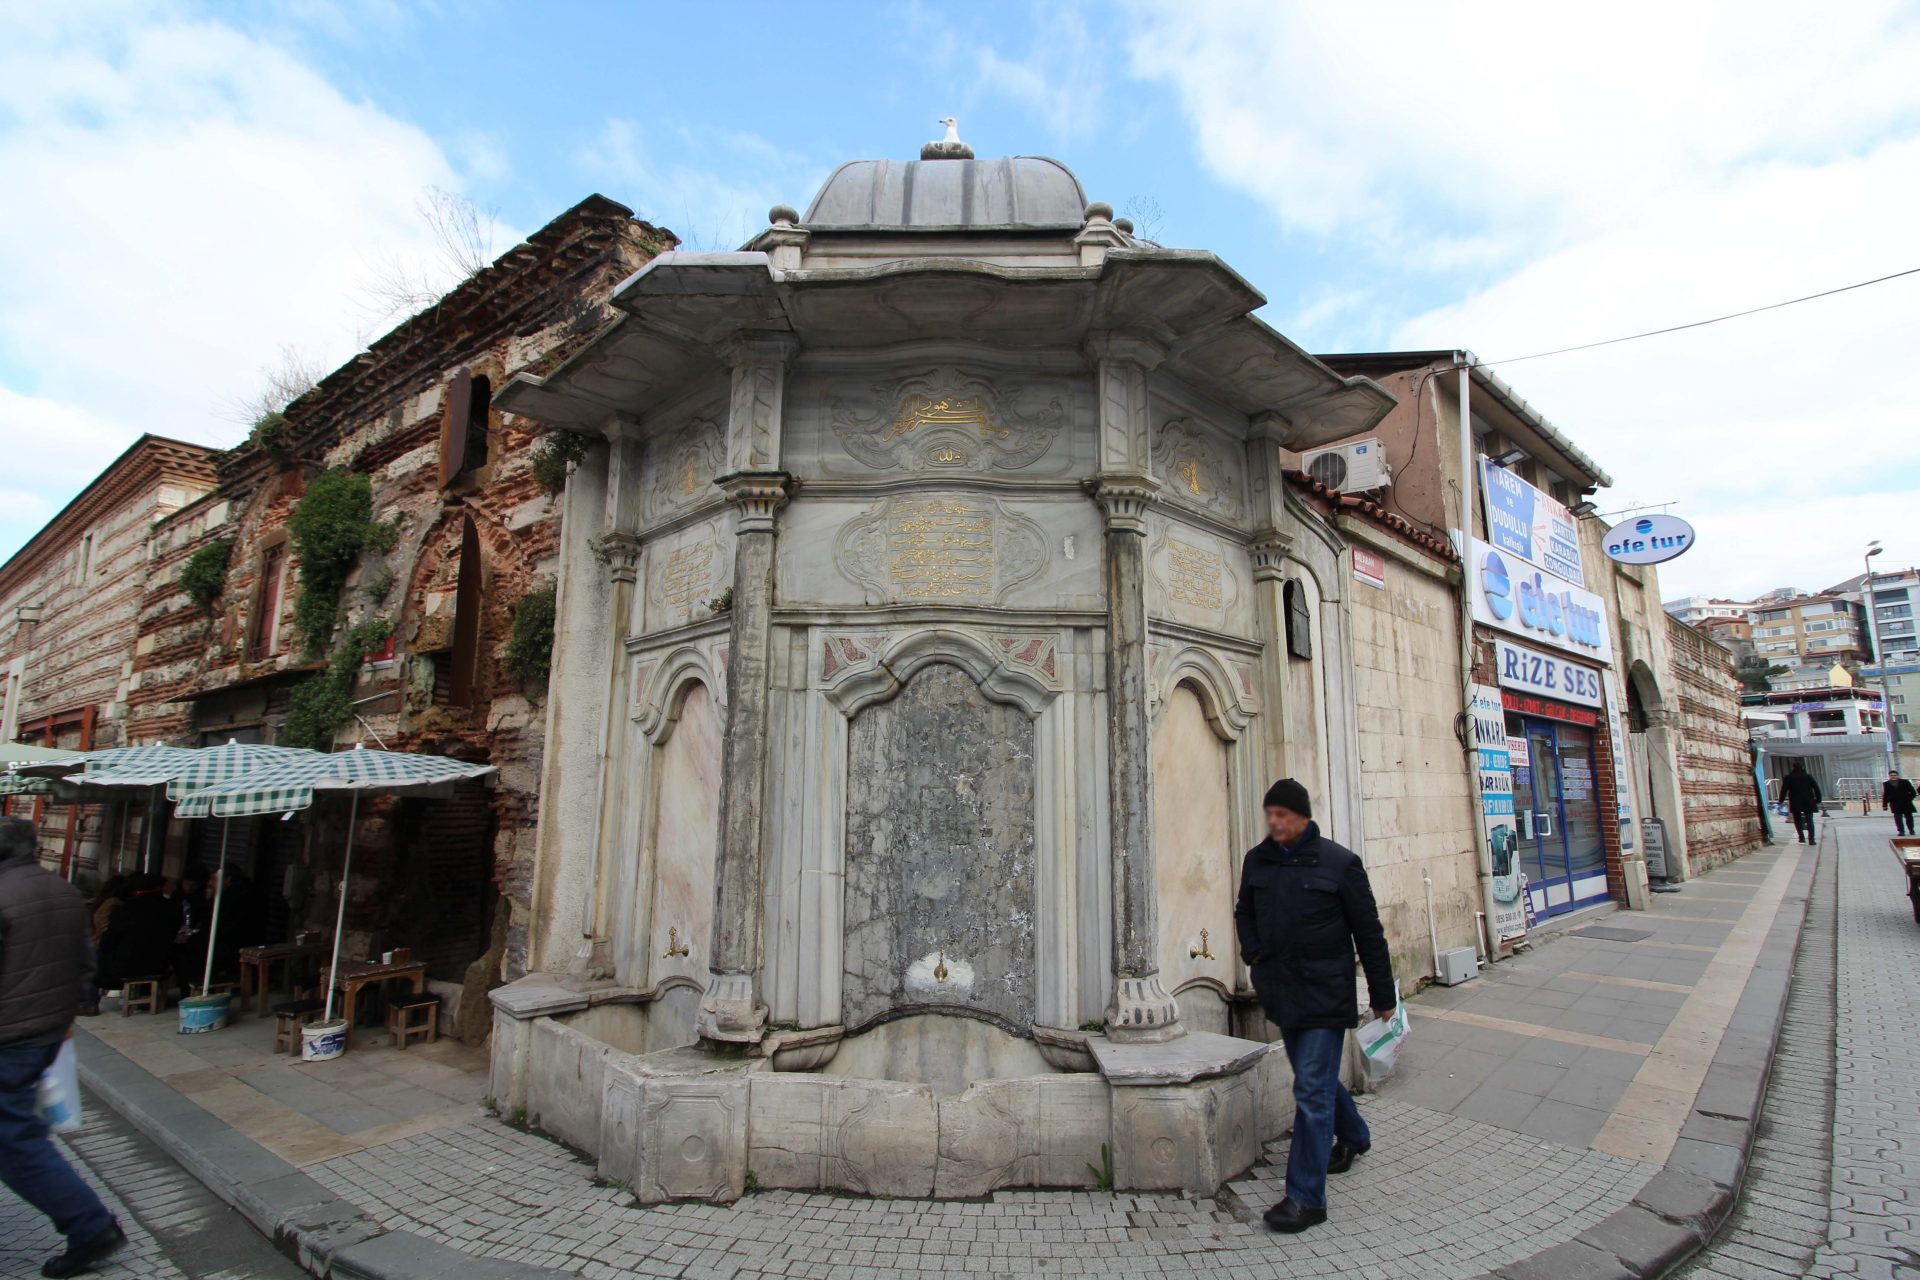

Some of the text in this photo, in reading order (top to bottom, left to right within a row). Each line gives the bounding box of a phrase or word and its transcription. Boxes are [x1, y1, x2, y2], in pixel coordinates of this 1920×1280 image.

[1492, 505, 1527, 538] DUDULLU
[1609, 535, 1686, 555] efe tur
[1545, 555, 1580, 580] ZONGULDAK
[1516, 573, 1601, 648] efe tur
[1564, 667, 1598, 699] SES
